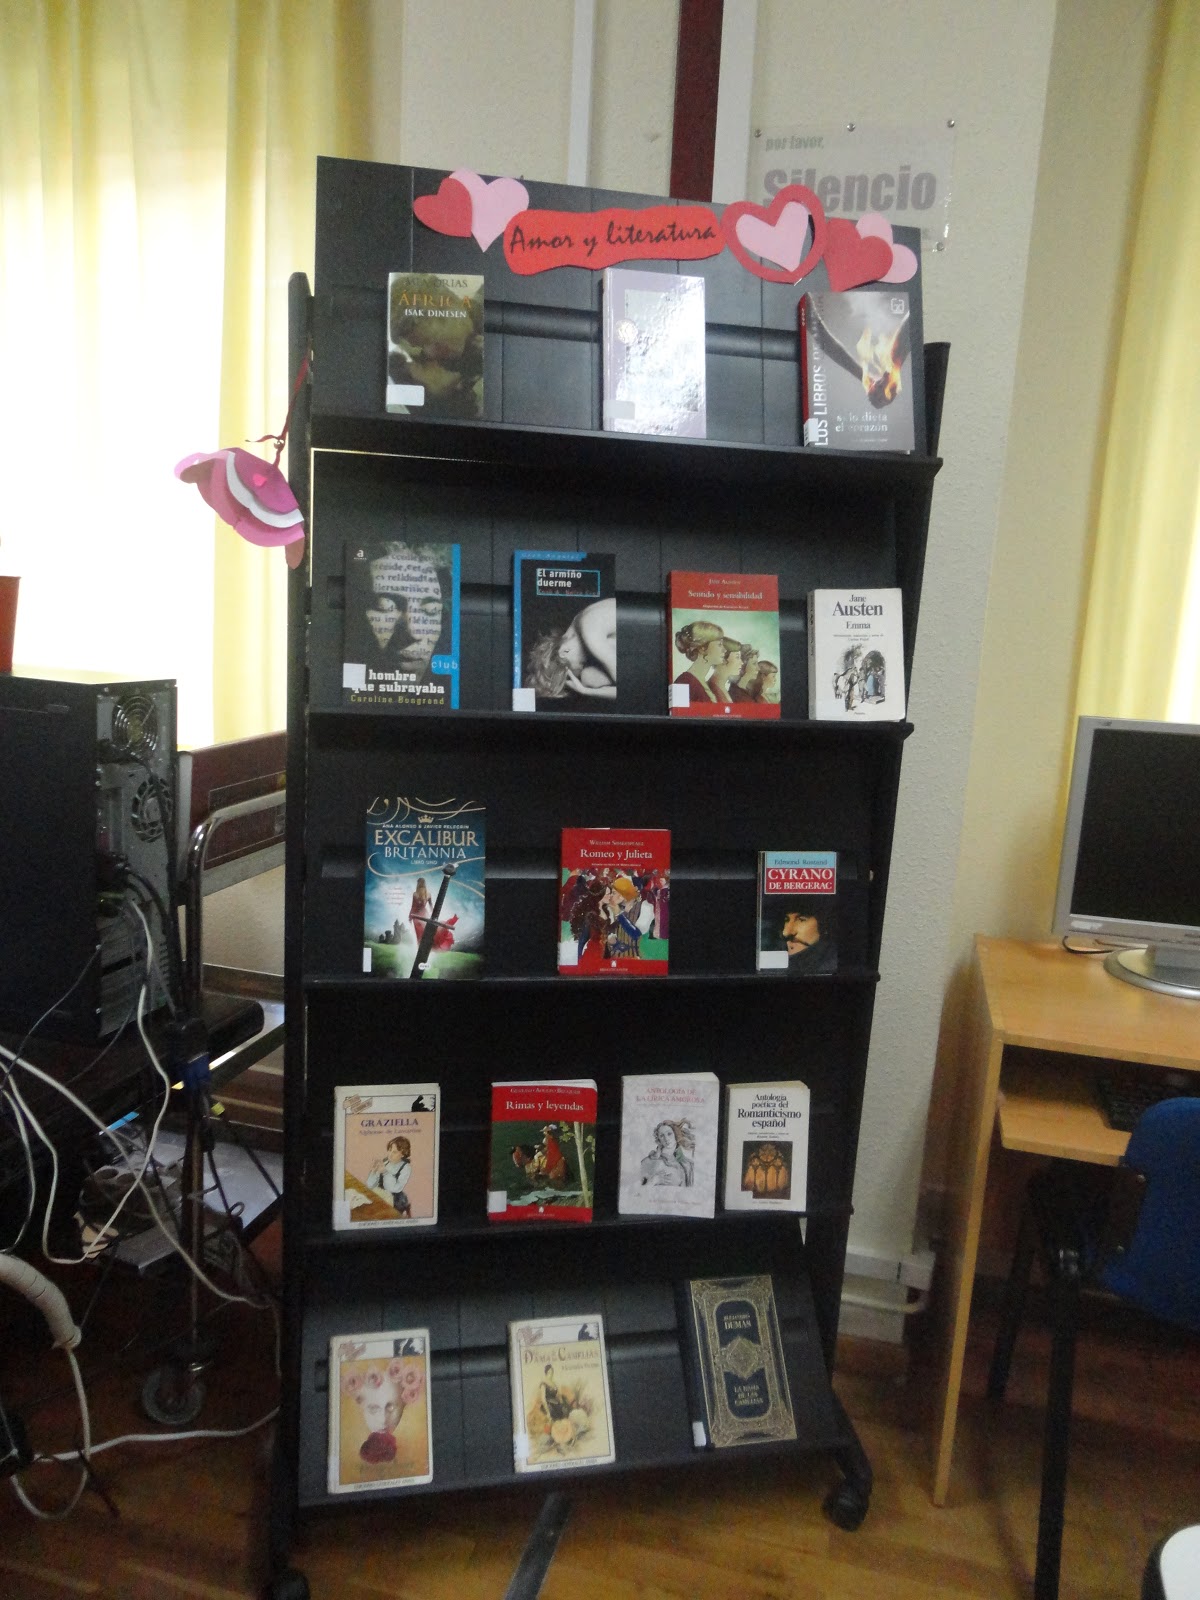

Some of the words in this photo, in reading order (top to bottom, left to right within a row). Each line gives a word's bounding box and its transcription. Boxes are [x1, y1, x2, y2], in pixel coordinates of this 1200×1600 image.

[766, 138, 787, 151] por
[510, 225, 575, 254] Amor
[583, 235, 599, 257] y
[606, 220, 717, 245] literatura
[404, 308, 425, 316] ISAK
[427, 309, 468, 318] DINESEN
[812, 365, 829, 416] LIBROS
[537, 568, 547, 578] El
[549, 569, 582, 579] armiño
[537, 578, 572, 588] duerme
[688, 589, 715, 599] Sentido
[722, 591, 763, 600] sensibilidad
[849, 593, 867, 603] Jane
[832, 601, 884, 617] Austen
[846, 621, 871, 630] Emma
[431, 661, 459, 669] club
[368, 668, 417, 682] hombre
[378, 681, 445, 696] subrayaba
[350, 694, 394, 703] Caroline
[374, 829, 480, 847] EXCALIBUR
[384, 846, 467, 860] BRITANNIA
[580, 848, 615, 859] Romeo
[617, 852, 623, 861] y
[624, 849, 653, 861] Julieta
[767, 868, 834, 880] CYRANO
[768, 881, 782, 890] DE
[783, 881, 833, 890] BERGERAC
[505, 1100, 535, 1110] Rimas
[537, 1102, 543, 1111] y
[546, 1100, 584, 1112] leyendas
[751, 1100, 776, 1109] poética
[737, 1108, 802, 1119] Romanticismo
[360, 1118, 419, 1128] GRAZIELLA
[752, 1118, 786, 1129] español
[724, 1320, 752, 1330] DUMAS
